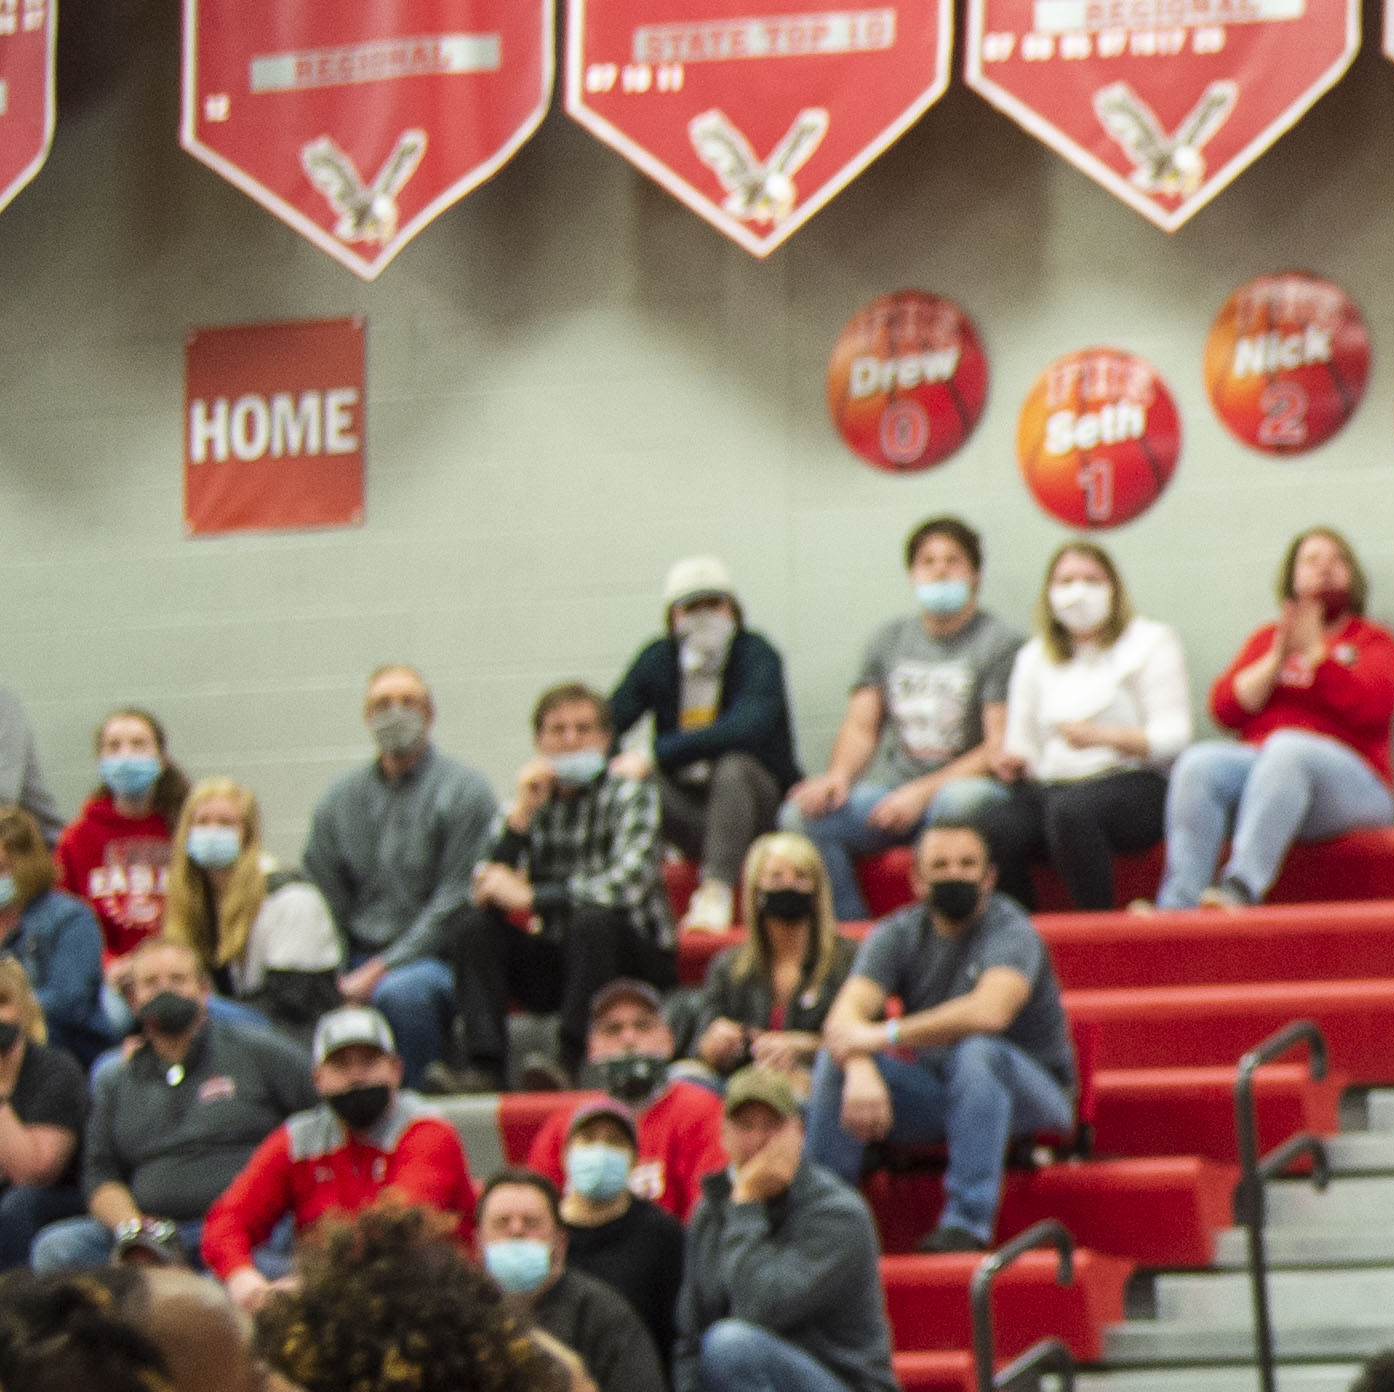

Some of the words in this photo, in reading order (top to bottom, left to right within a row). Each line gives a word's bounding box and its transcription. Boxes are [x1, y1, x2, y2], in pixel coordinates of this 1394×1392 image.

[849, 345, 960, 397] Drew
[1233, 329, 1332, 378] Nick
[189, 387, 360, 463] HOME
[880, 401, 929, 463] 0
[1045, 402, 1145, 456] Seth
[1258, 382, 1309, 445] 2
[1077, 458, 1113, 521] 1
